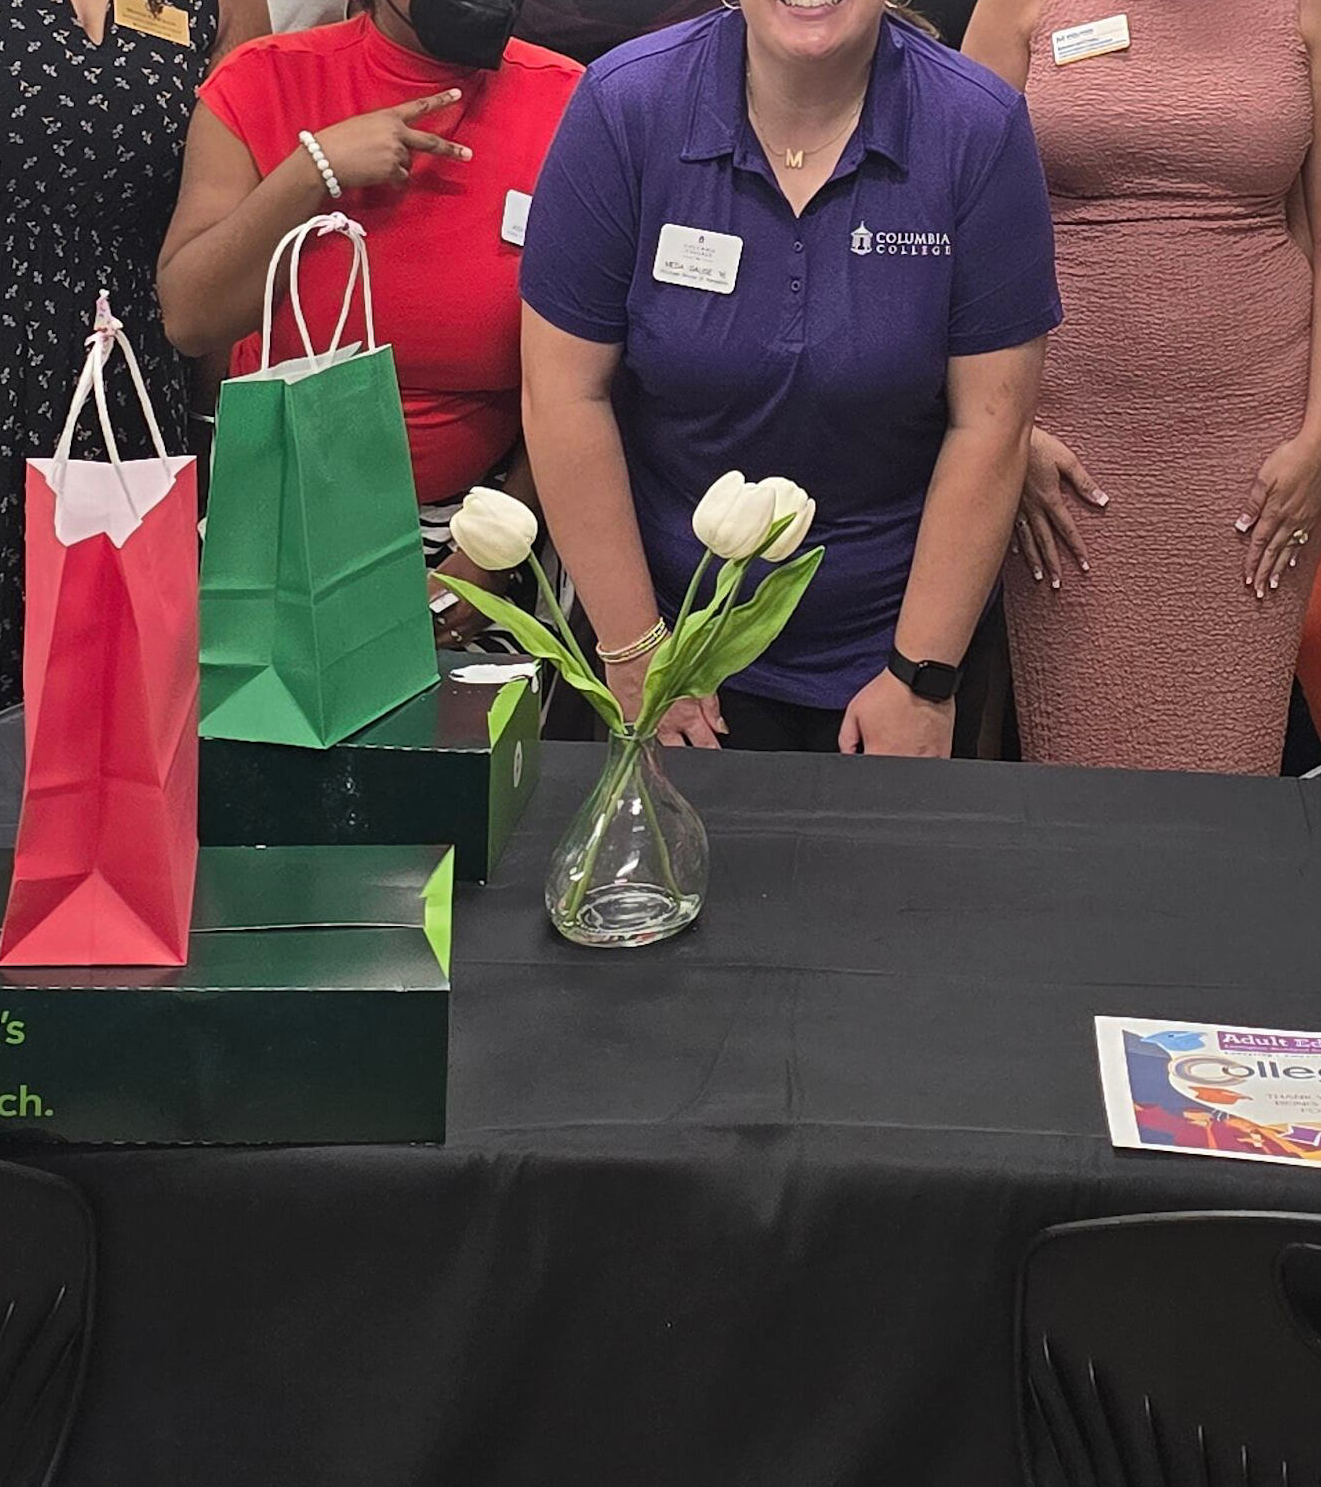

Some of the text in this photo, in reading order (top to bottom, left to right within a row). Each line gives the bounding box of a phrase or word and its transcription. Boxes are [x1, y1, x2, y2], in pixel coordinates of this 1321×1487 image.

[876, 231, 951, 245] COLUMBIA
[876, 245, 952, 256] COLLEGE
[1222, 1033, 1289, 1048] Adult
